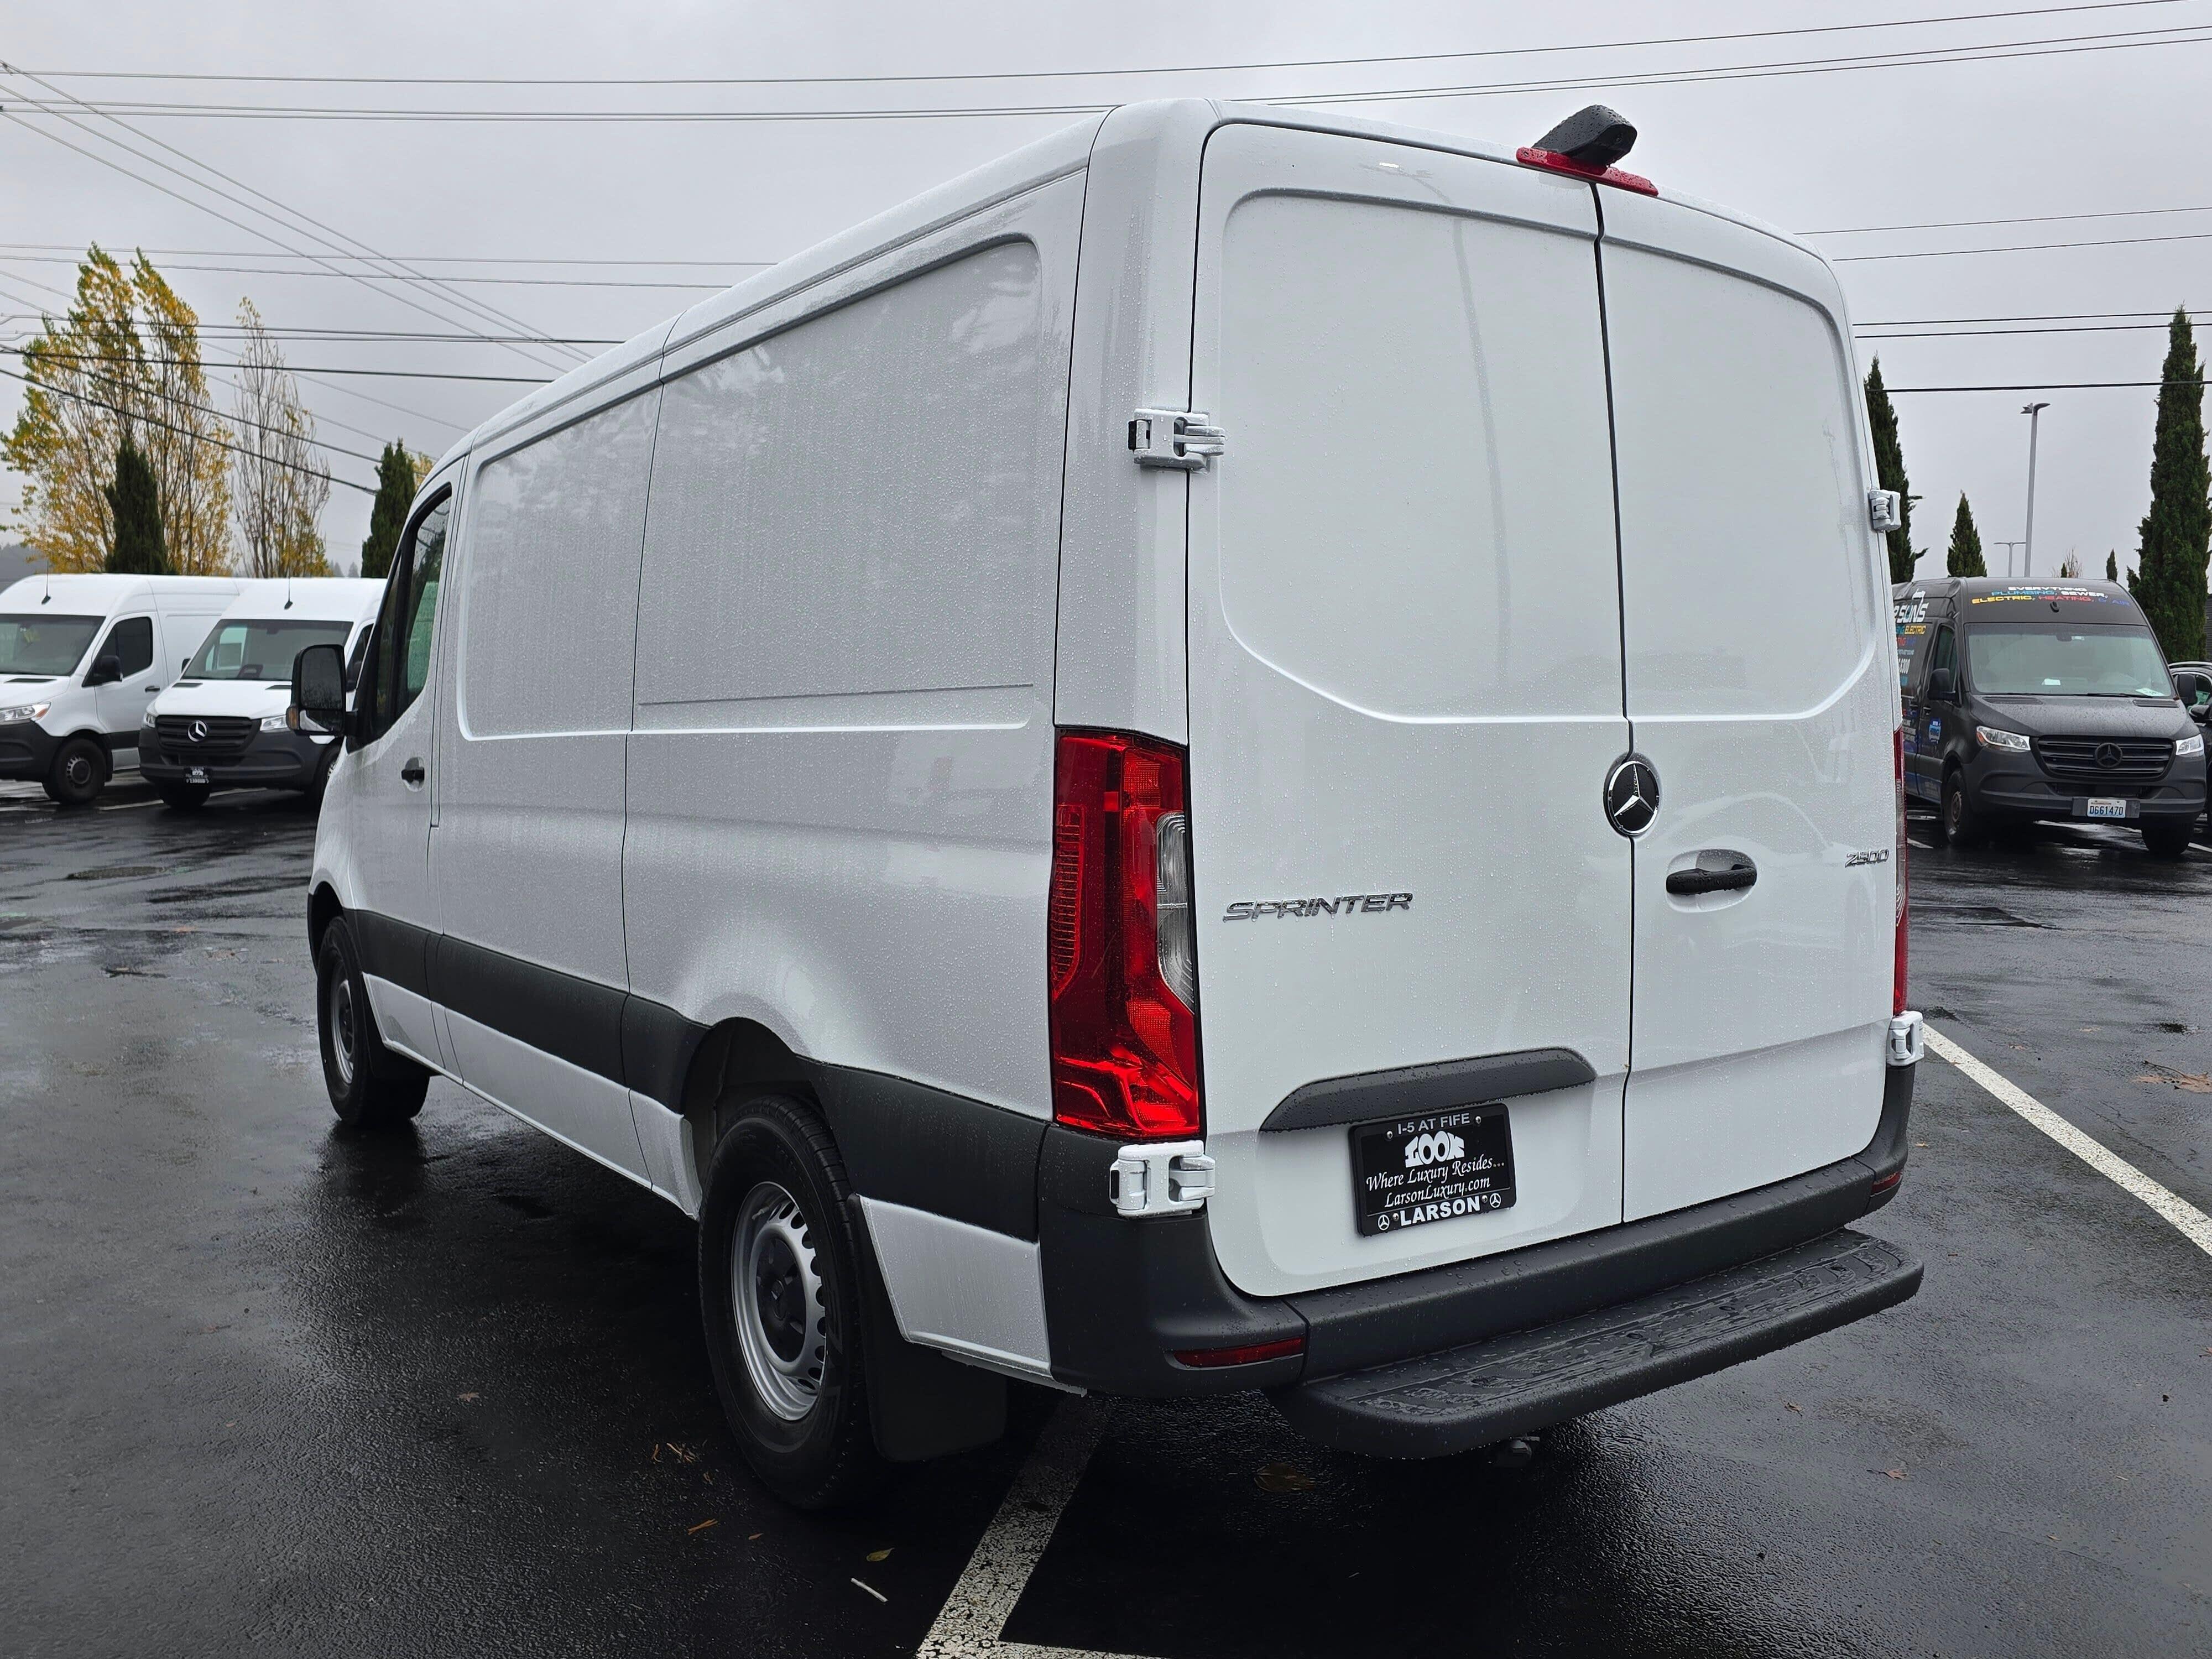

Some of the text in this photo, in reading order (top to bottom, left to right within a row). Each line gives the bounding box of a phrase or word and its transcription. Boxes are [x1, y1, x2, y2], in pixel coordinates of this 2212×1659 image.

[1845, 848, 1889, 868] 2500
[1223, 892, 1413, 923] SPRINTER
[1397, 1113, 1470, 1134] I-5 AT FIFE
[1405, 1130, 1465, 1168] LOOK
[1366, 1154, 1505, 1191] Where Luxury Resides...
[1384, 1177, 1491, 1208] LarsonLuxury.com
[1400, 1196, 1480, 1227] LARSON
